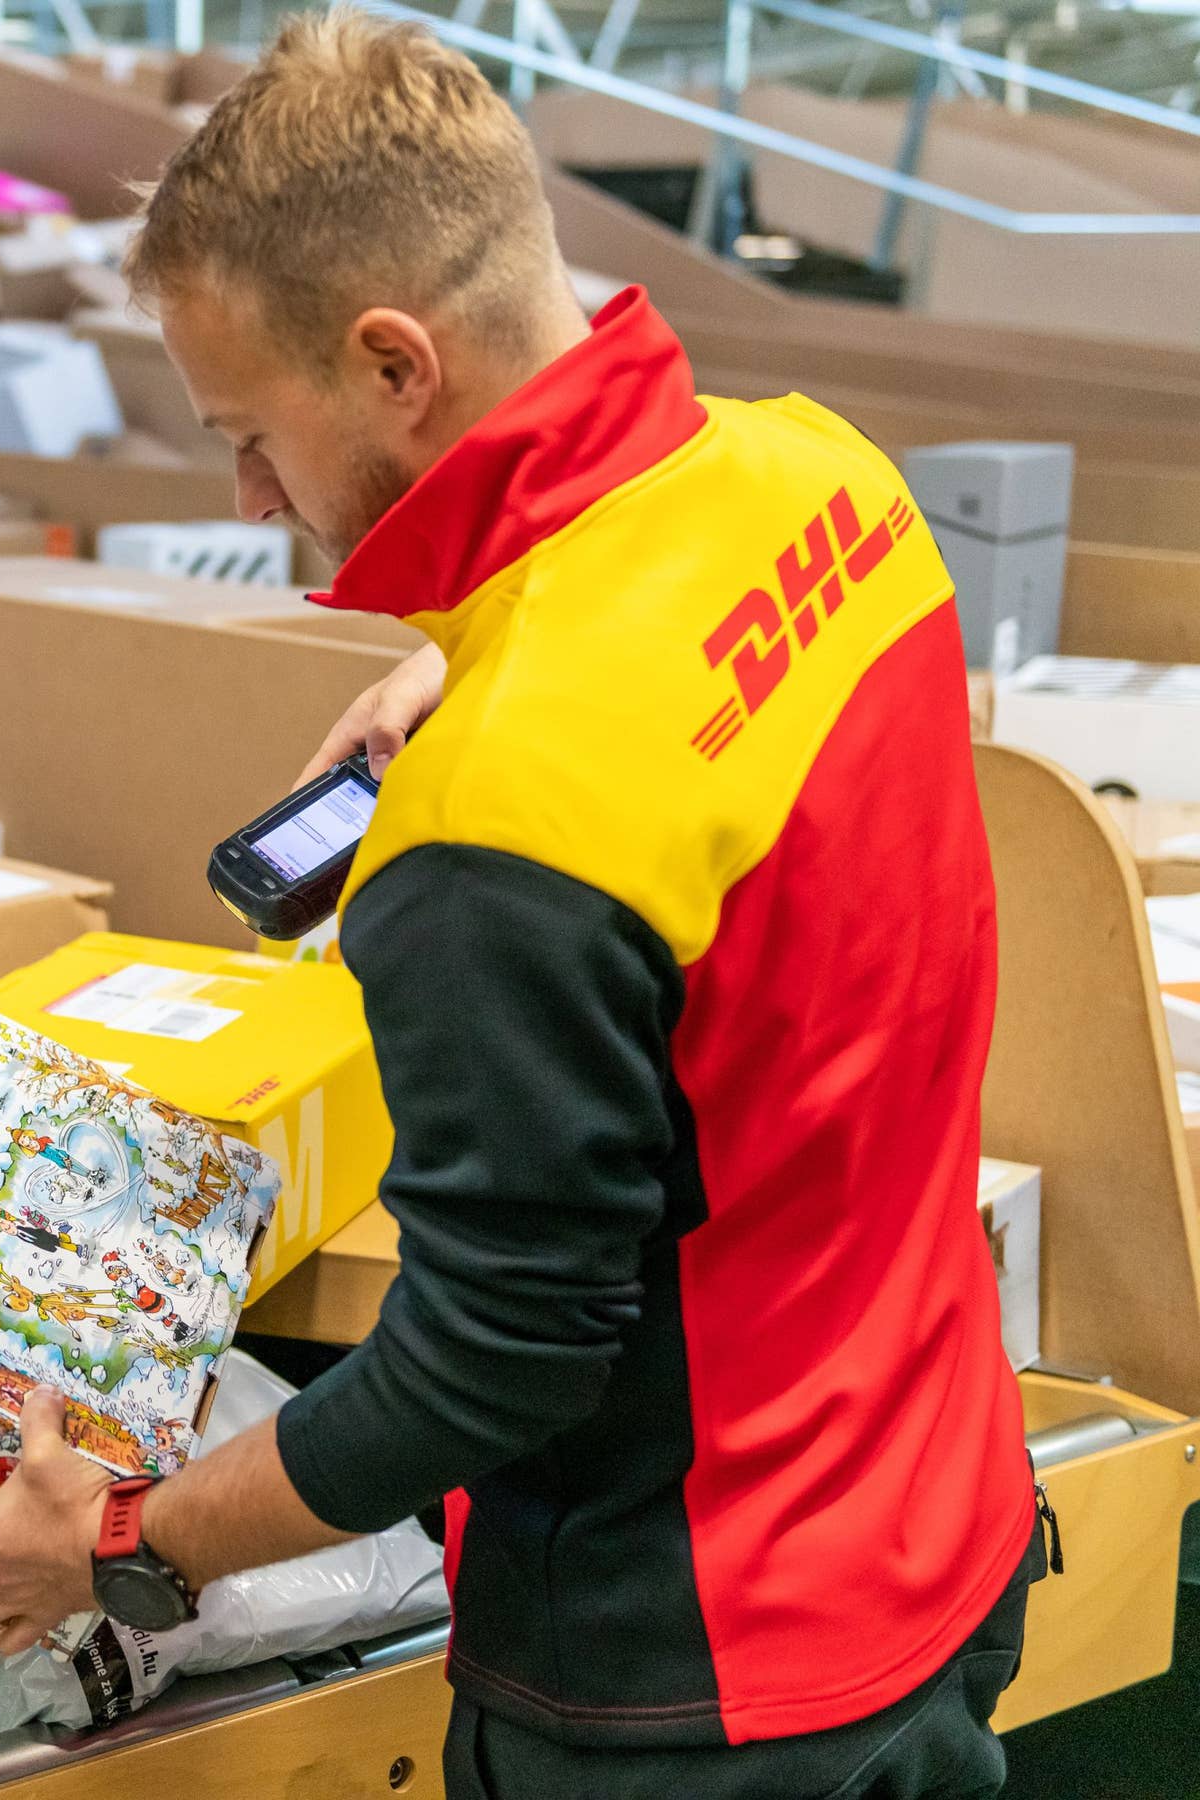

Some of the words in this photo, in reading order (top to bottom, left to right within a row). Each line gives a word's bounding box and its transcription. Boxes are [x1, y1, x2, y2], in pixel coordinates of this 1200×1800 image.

[701, 485, 895, 718] DHL
[234, 1077, 282, 1107] DHL
[129, 1627, 159, 1678] dl.hu
[100, 1680, 114, 1696] za
